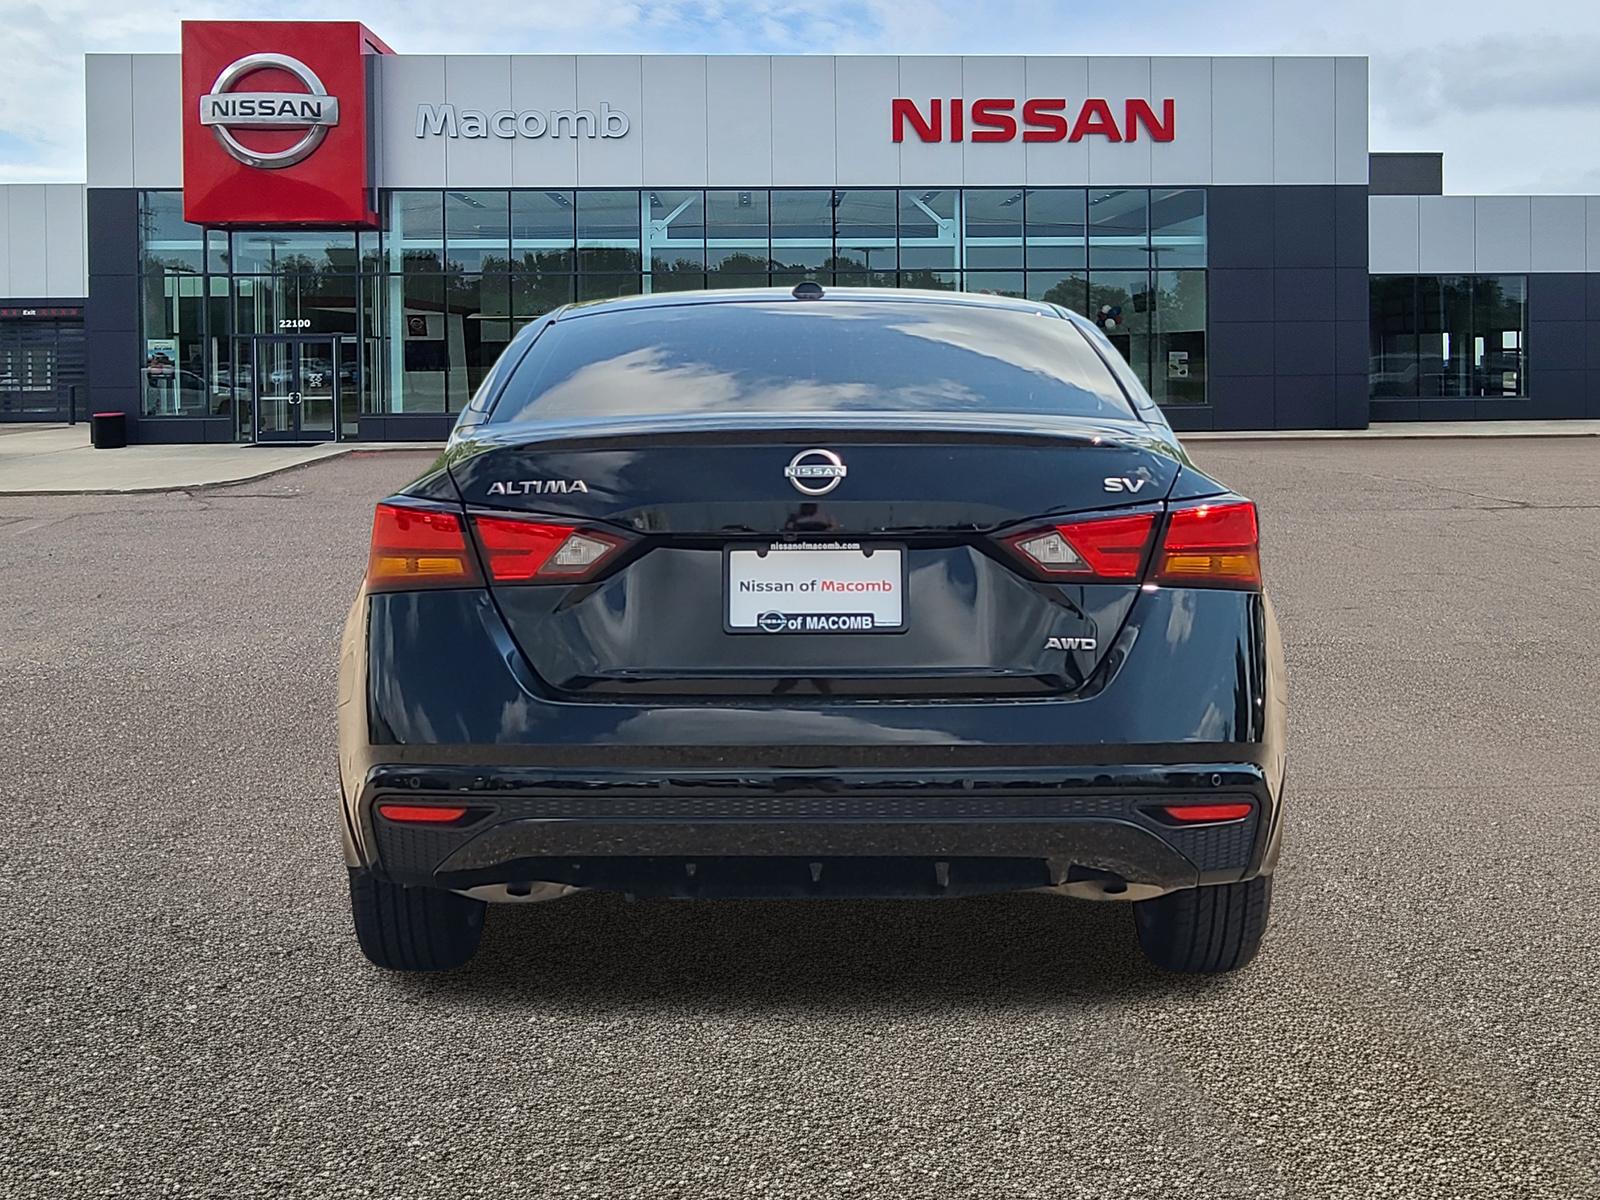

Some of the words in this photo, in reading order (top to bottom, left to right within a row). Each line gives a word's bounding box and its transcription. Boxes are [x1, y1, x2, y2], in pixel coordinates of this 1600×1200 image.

[212, 100, 322, 117] NISSAN
[415, 102, 630, 138] Macomb
[892, 98, 1175, 143] NISSAN
[279, 319, 311, 328] 22100
[786, 467, 843, 476] NISSAN
[486, 480, 589, 496] ALTIMA
[1104, 477, 1145, 493] SV
[770, 541, 860, 550] nissanofmacomb.com
[740, 579, 794, 593] Nissan
[799, 579, 817, 593] of
[821, 580, 892, 593] Macomb
[788, 616, 802, 630] of
[806, 616, 873, 630] MACOMB
[1044, 637, 1097, 650] AWD
